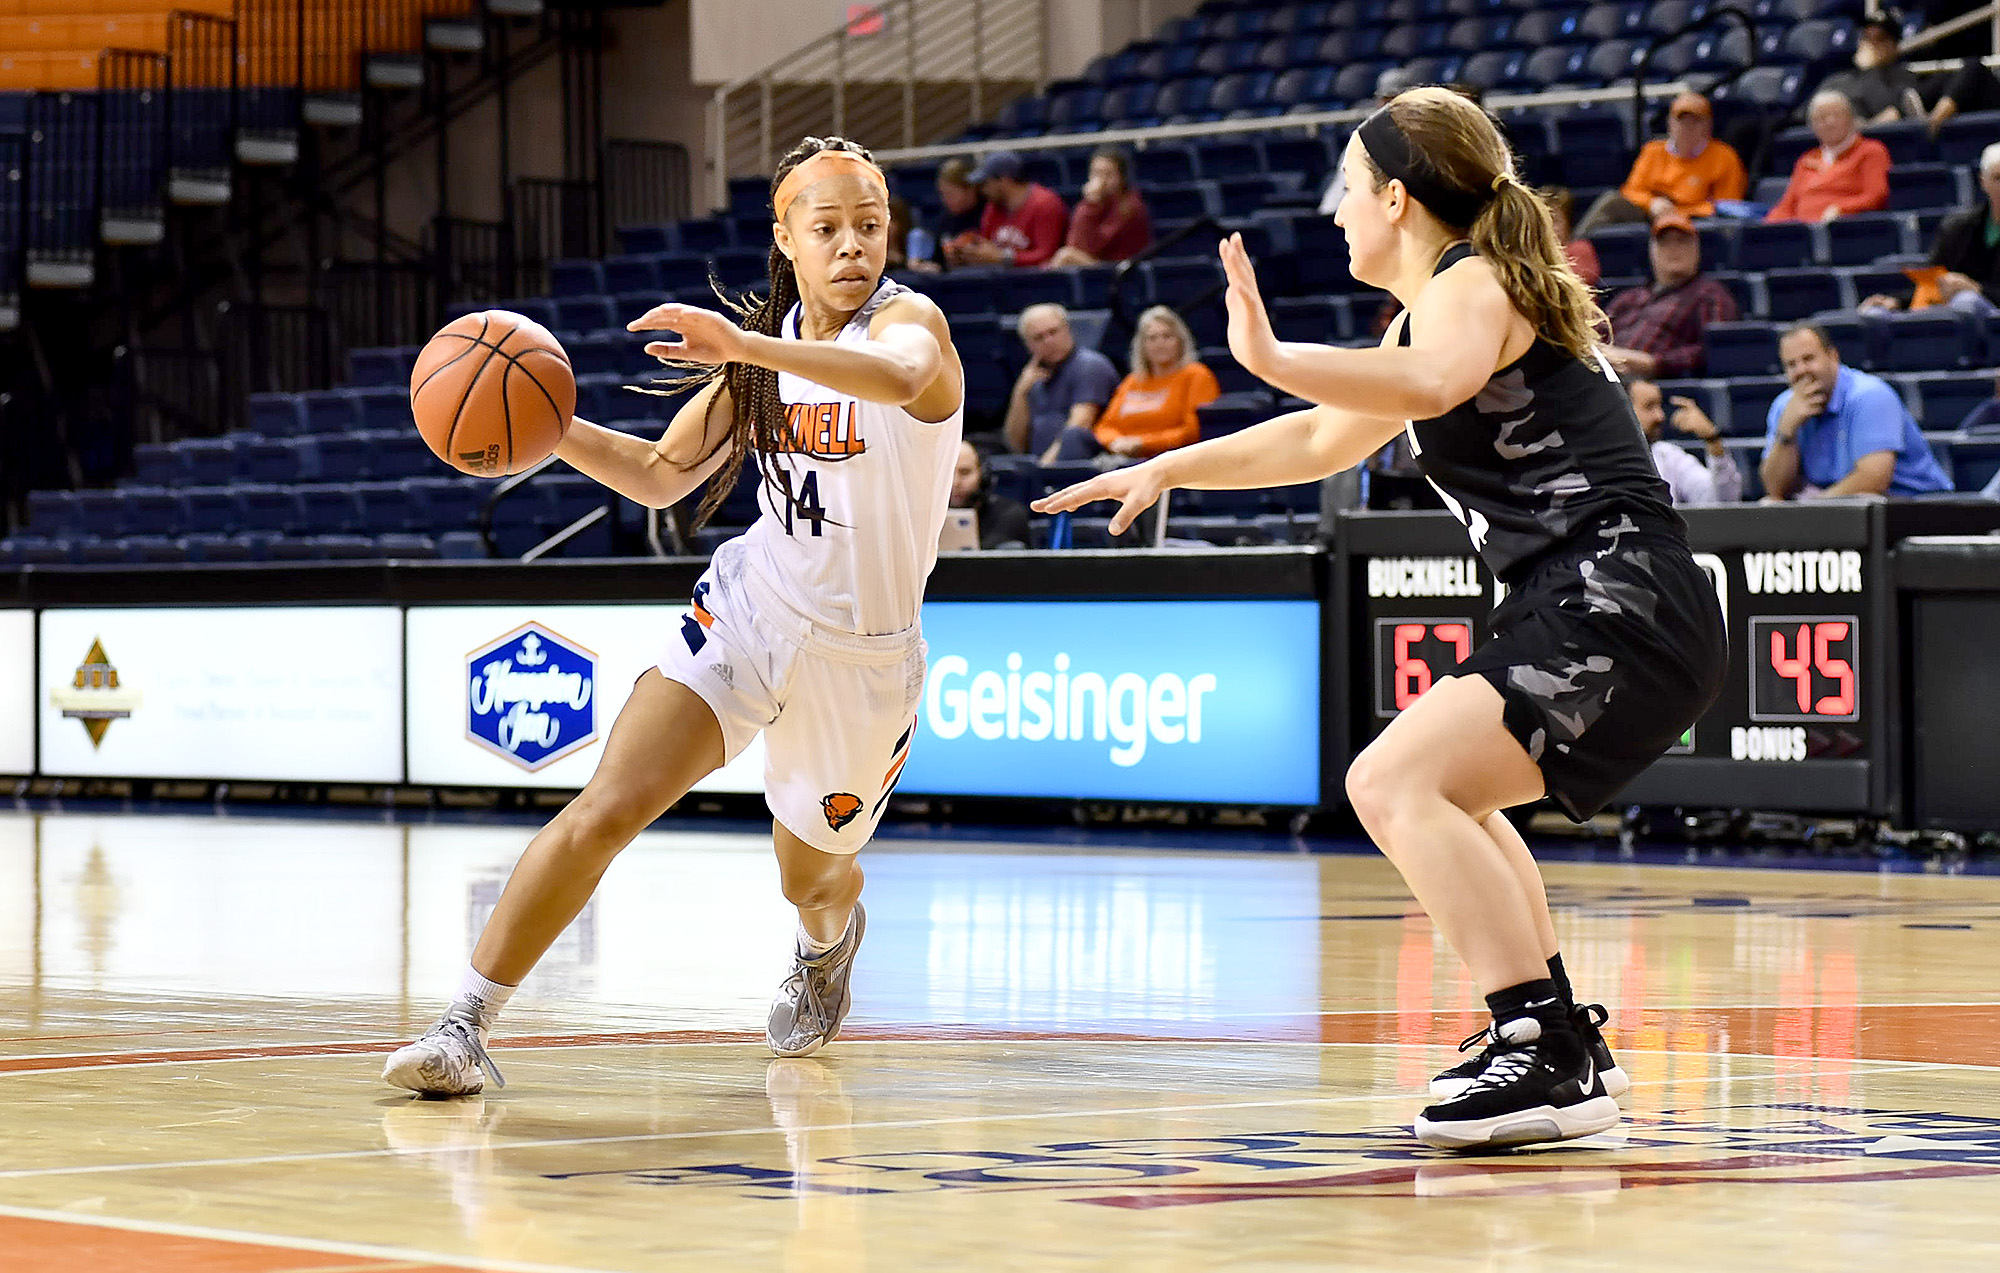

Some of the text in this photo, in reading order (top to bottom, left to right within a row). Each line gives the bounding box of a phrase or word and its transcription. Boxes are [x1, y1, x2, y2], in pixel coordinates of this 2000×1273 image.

[752, 401, 866, 455] KNELL
[781, 469, 826, 537] 14
[1368, 556, 1483, 598] BUCKNELL
[1742, 550, 1863, 594] VISITOR
[1771, 621, 1855, 715] 45
[926, 652, 1217, 767] Geisinger
[1731, 726, 1807, 761] BONUS
